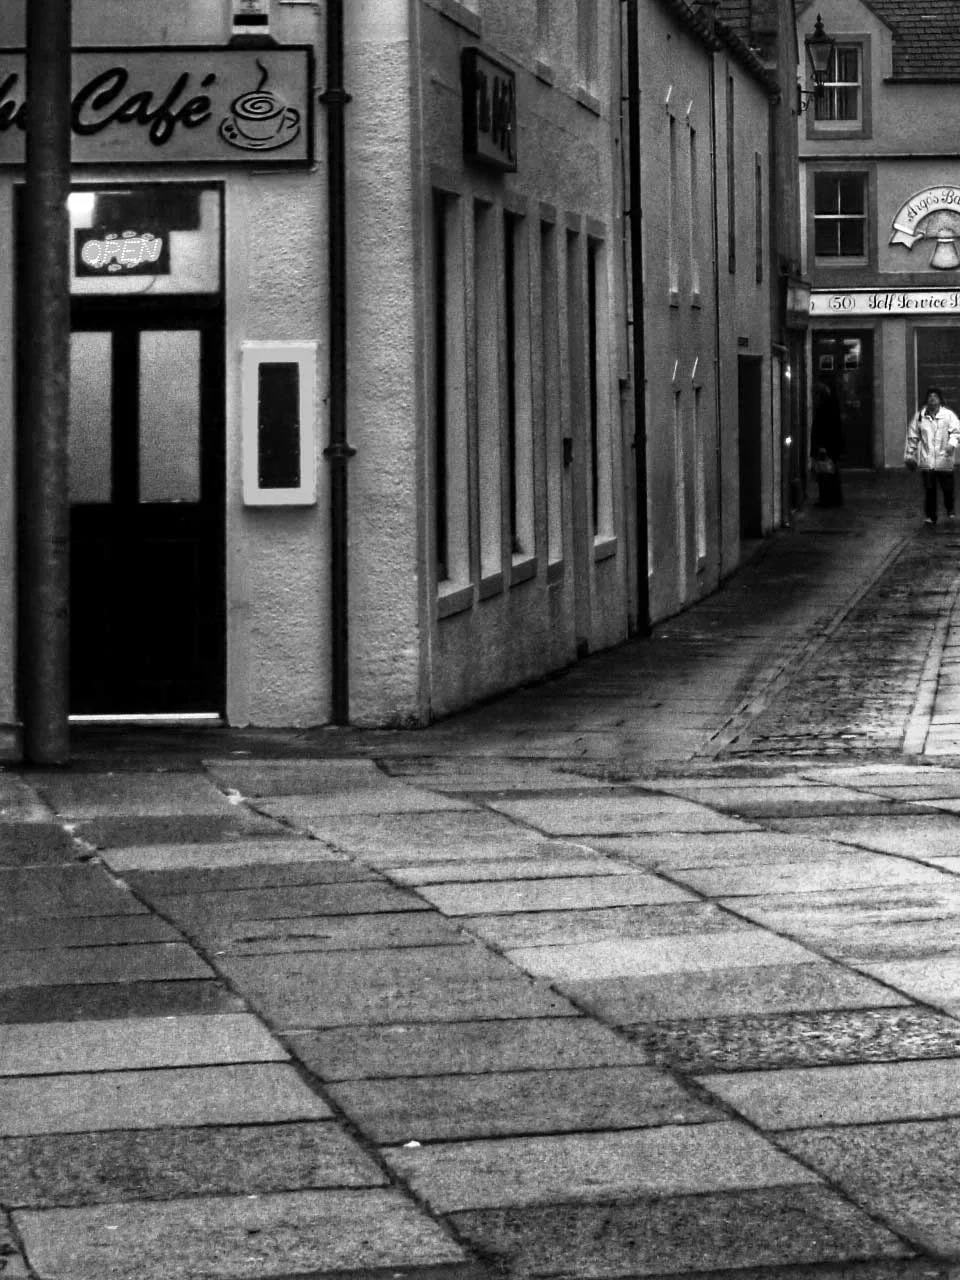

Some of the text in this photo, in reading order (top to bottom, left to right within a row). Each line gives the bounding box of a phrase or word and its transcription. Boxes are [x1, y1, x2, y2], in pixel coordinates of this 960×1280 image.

[70, 67, 216, 146] Café
[906, 192, 939, 222] Argo's
[82, 238, 162, 268] OPEN
[868, 293, 892, 311] Self
[897, 293, 946, 310] Service
